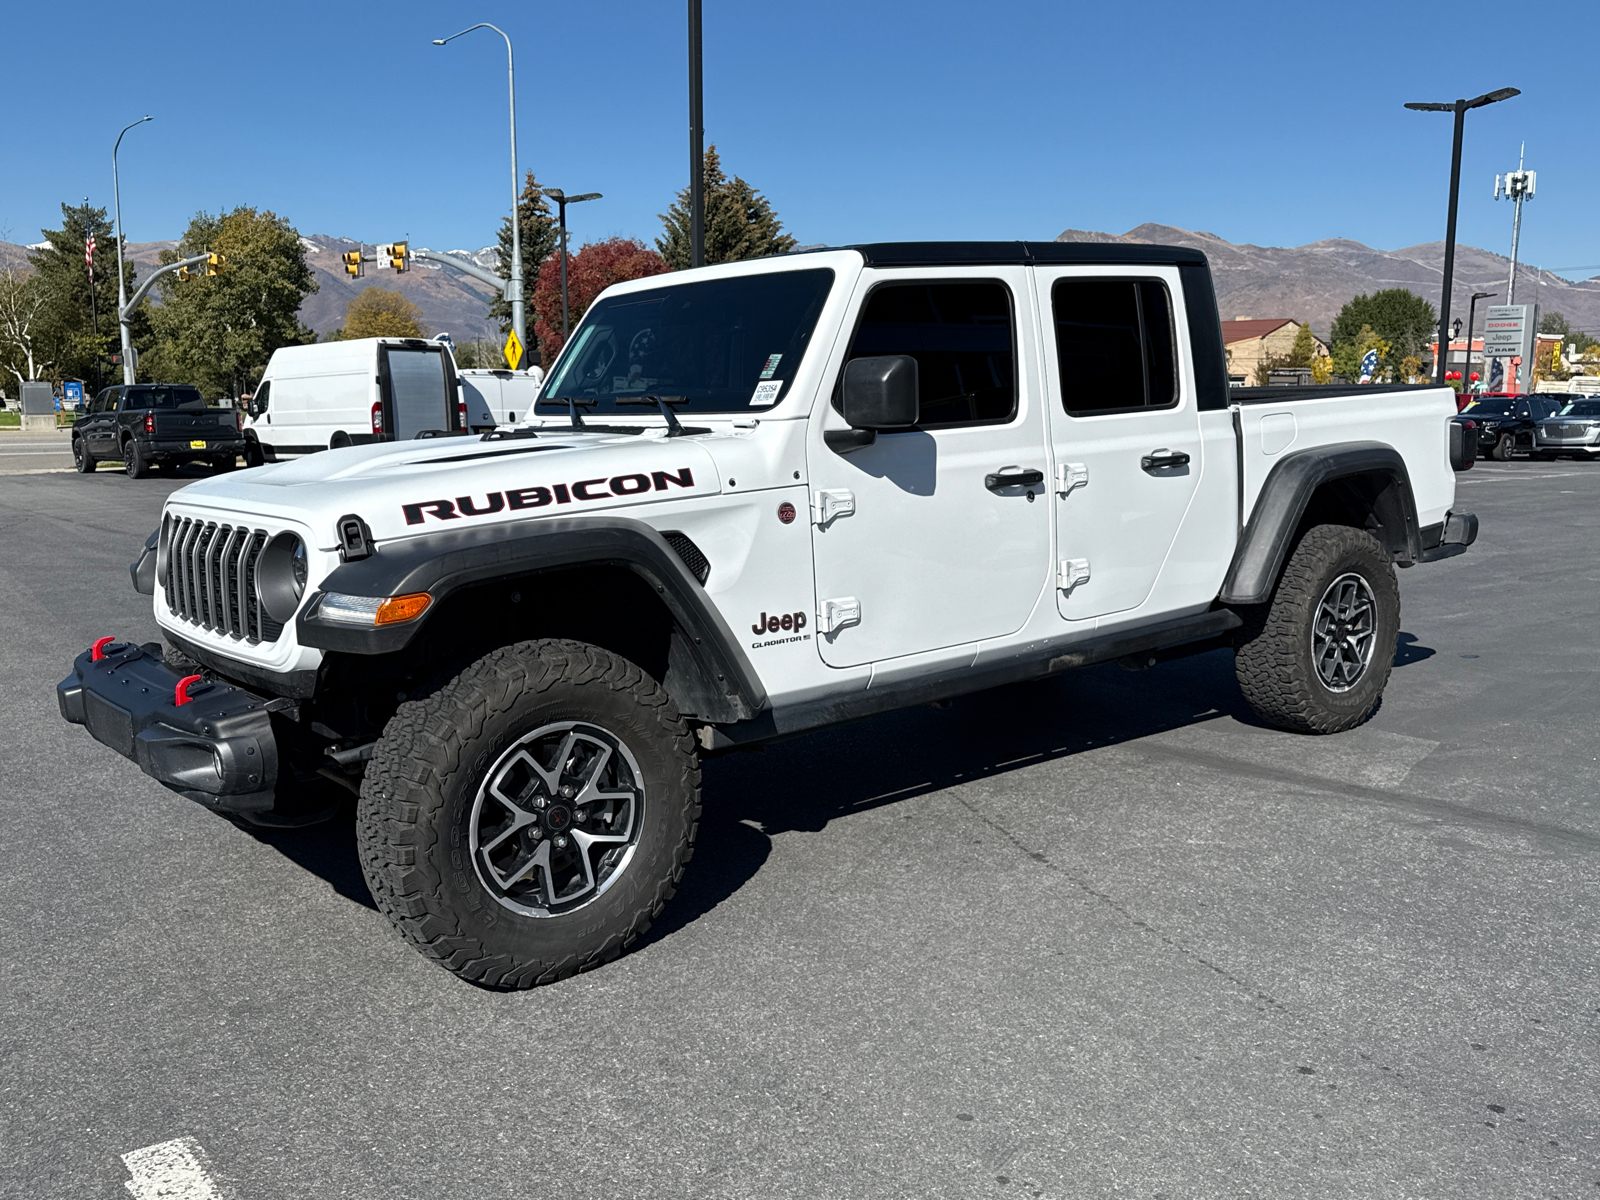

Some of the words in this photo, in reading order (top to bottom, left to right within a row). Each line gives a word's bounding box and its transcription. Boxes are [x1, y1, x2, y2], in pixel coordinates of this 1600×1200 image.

[1492, 333, 1512, 341] Jeep
[401, 467, 695, 526] RUBICON
[751, 611, 807, 636] Jeep
[751, 635, 803, 650] GLADIATOR
